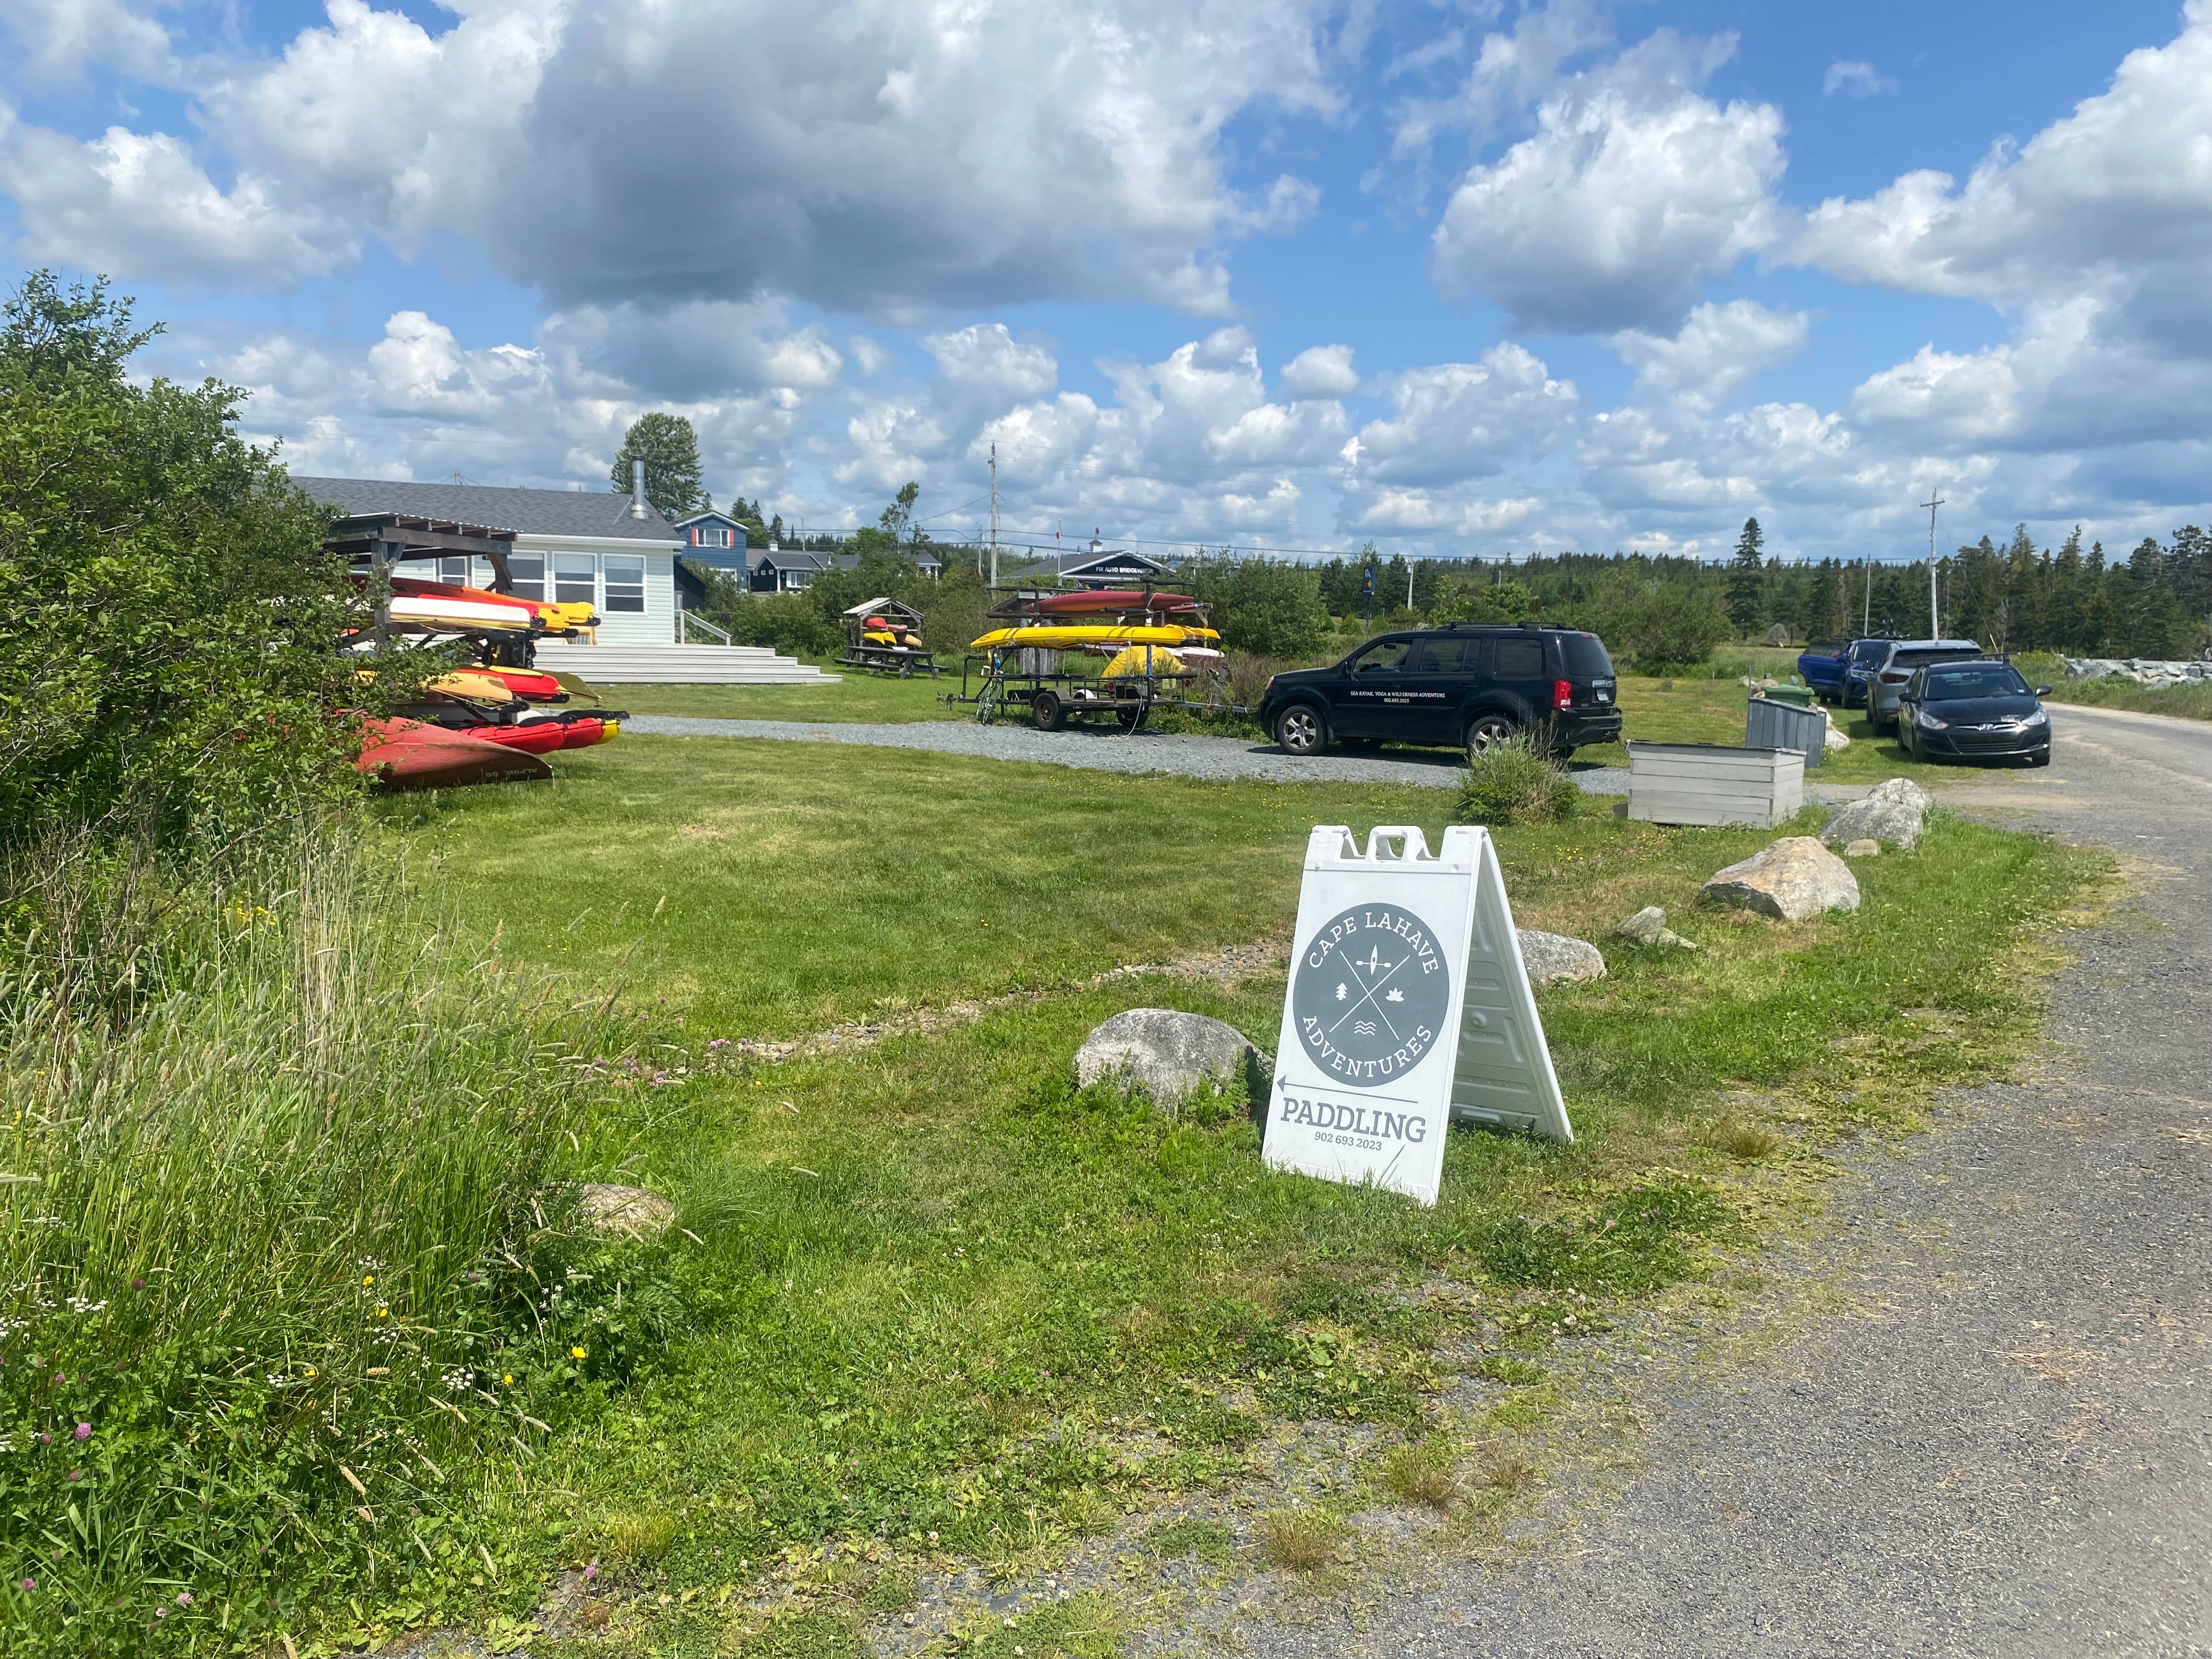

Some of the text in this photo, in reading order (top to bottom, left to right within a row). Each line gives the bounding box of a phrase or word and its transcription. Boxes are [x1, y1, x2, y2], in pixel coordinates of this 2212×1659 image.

[503, 768, 538, 778] ALPINE
[1309, 912, 1439, 975] CAPE LAHAVE
[1302, 1015, 1431, 1077] ADVENTURES
[1280, 1097, 1426, 1143] PADDLING
[1314, 1132, 1382, 1151] 902 693 2023
